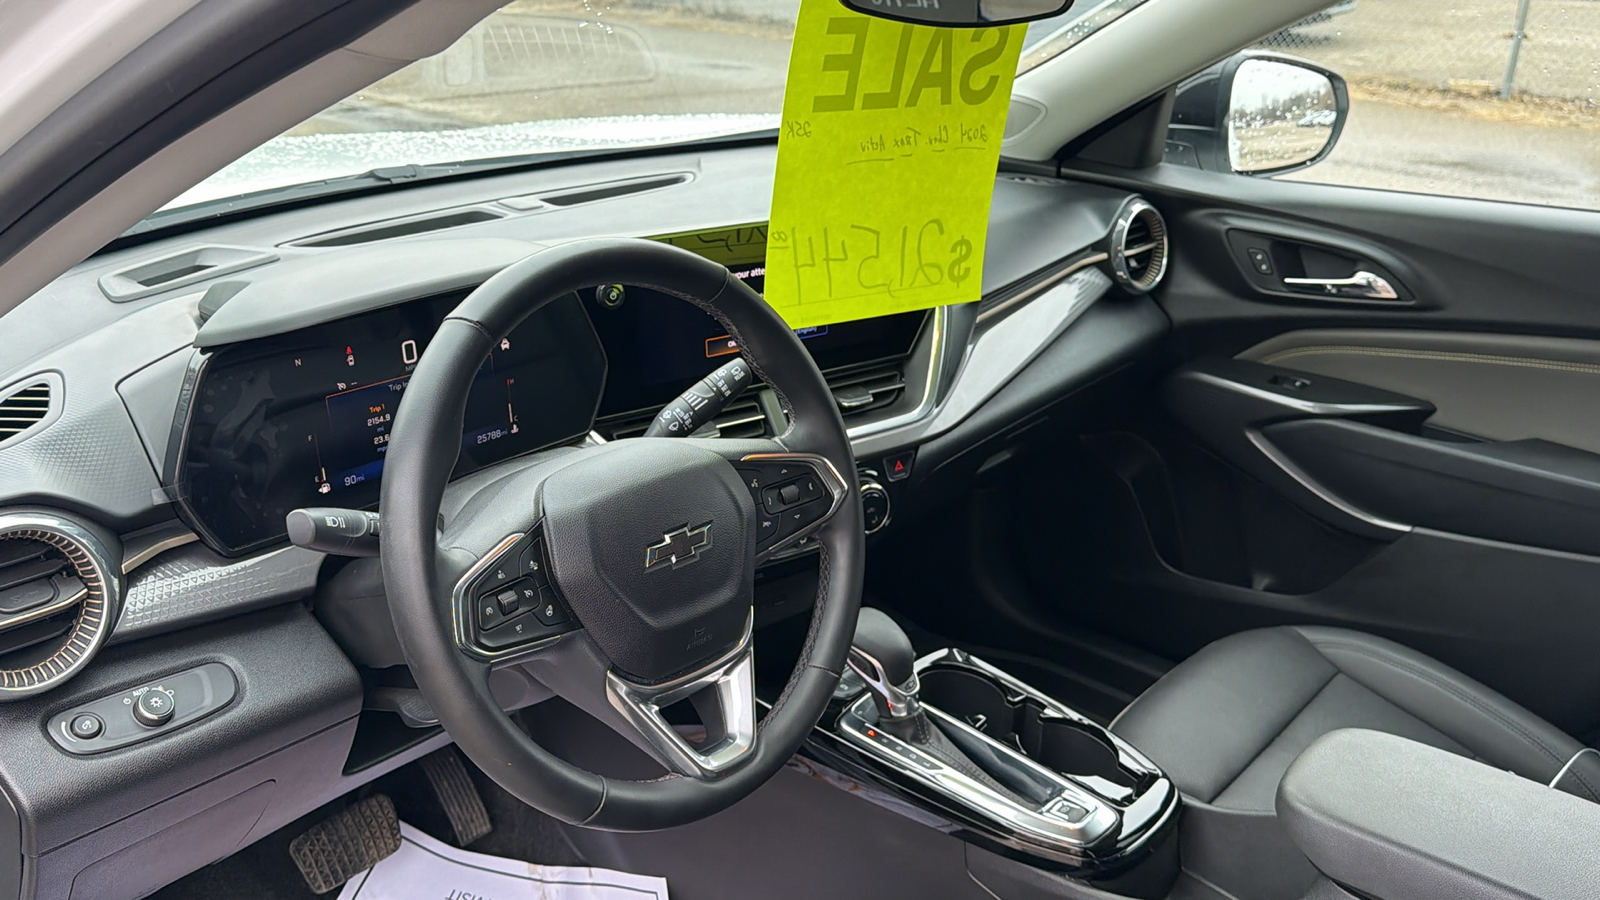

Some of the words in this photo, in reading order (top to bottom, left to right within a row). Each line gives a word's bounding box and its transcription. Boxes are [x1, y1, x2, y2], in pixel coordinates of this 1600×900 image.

[401, 340, 418, 364] 0
[294, 358, 302, 367] N
[388, 383, 402, 392] Trip
[367, 413, 391, 427] 2154.9
[308, 434, 313, 442] F
[373, 433, 390, 445] 23.6
[314, 475, 320, 483] E
